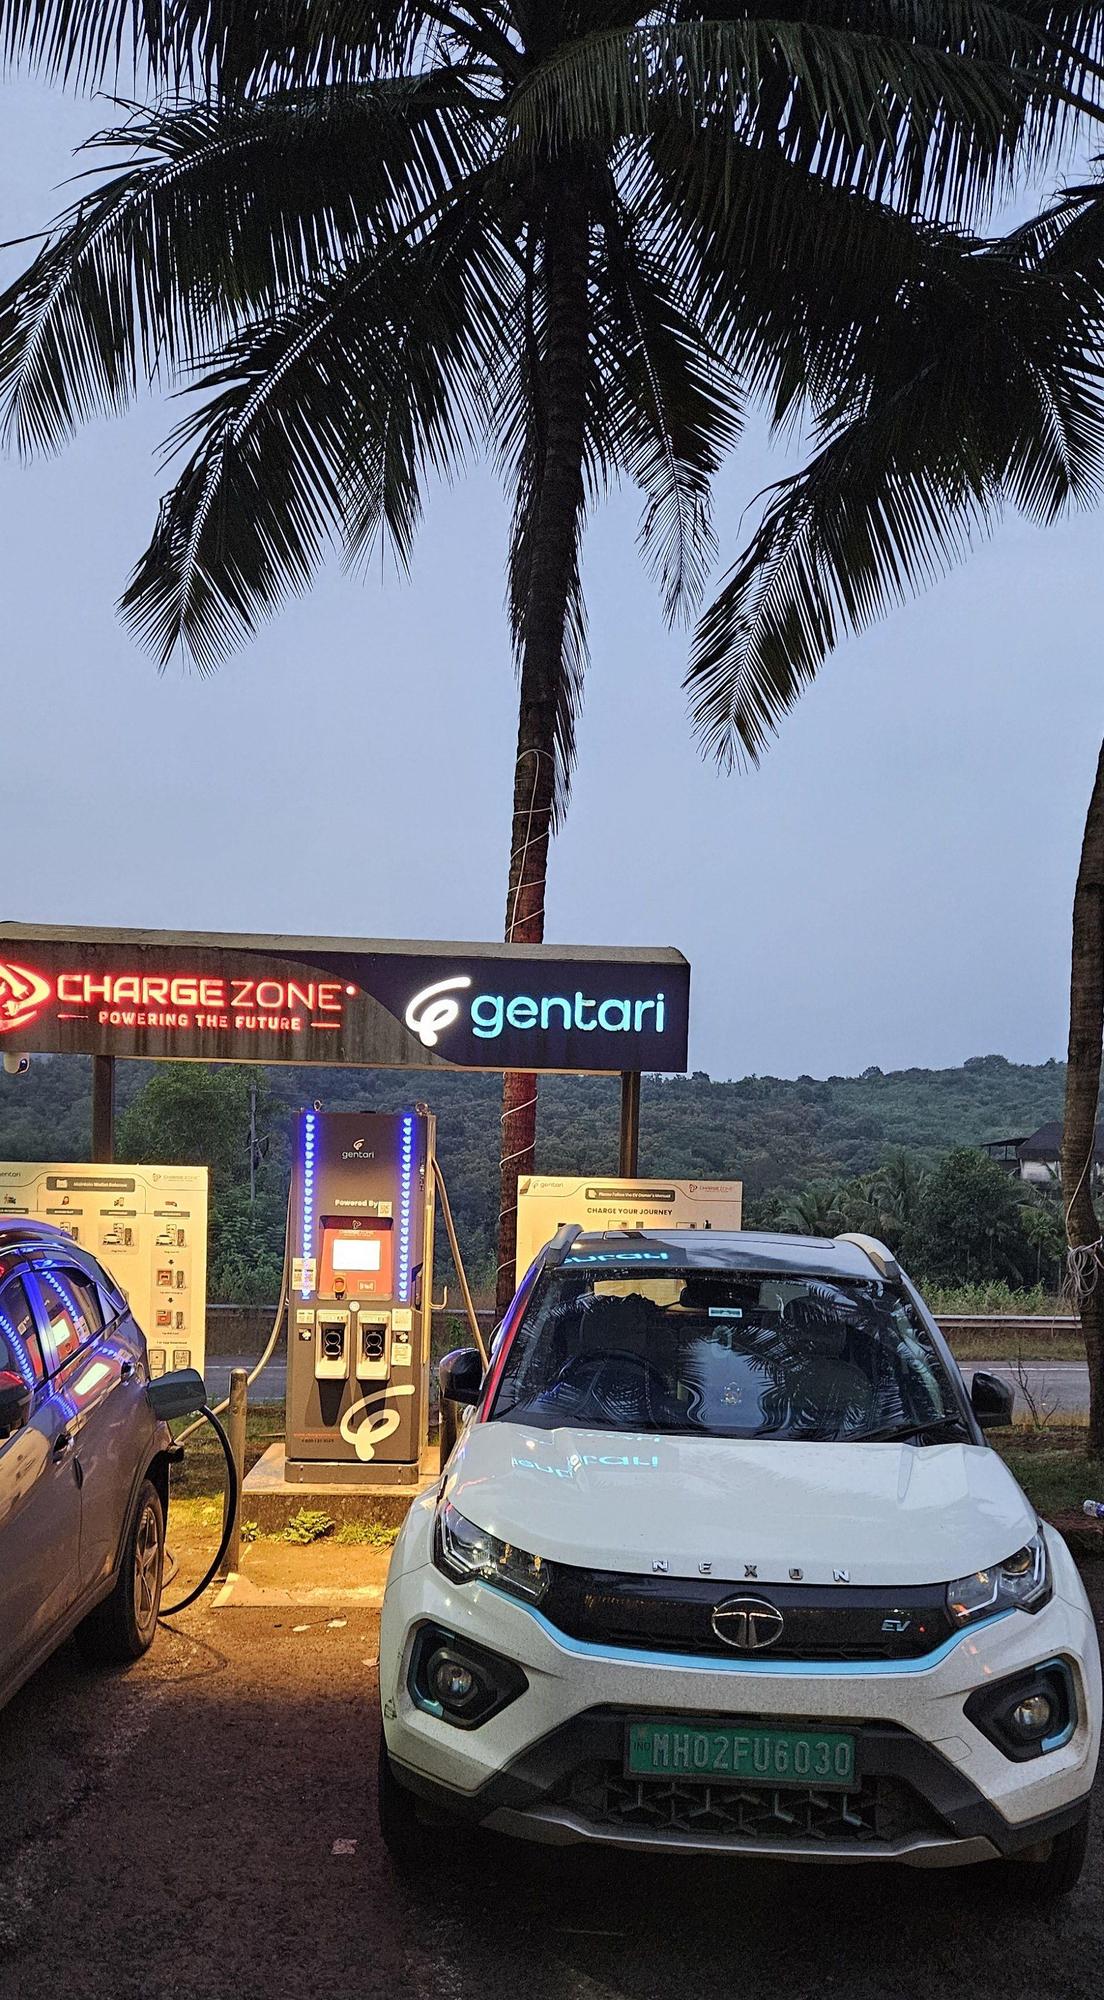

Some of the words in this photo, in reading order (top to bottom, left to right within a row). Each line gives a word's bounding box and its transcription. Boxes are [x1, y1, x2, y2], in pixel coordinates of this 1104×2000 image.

[57, 974, 225, 1006] CHARGE
[230, 980, 342, 1010] ZONE
[98, 1011, 189, 1027] POWERING
[195, 1014, 228, 1029] THE
[235, 1015, 301, 1031] FUTURE
[470, 991, 665, 1039] gentari
[341, 1151, 375, 1160] gentari
[334, 1199, 368, 1207] Powered
[368, 1200, 378, 1209] By
[639, 1208, 673, 1216] JOURNEY
[651, 1559, 851, 1583] NEXON
[881, 1619, 912, 1632] EV
[652, 1733, 851, 1776] MH02FU6030
